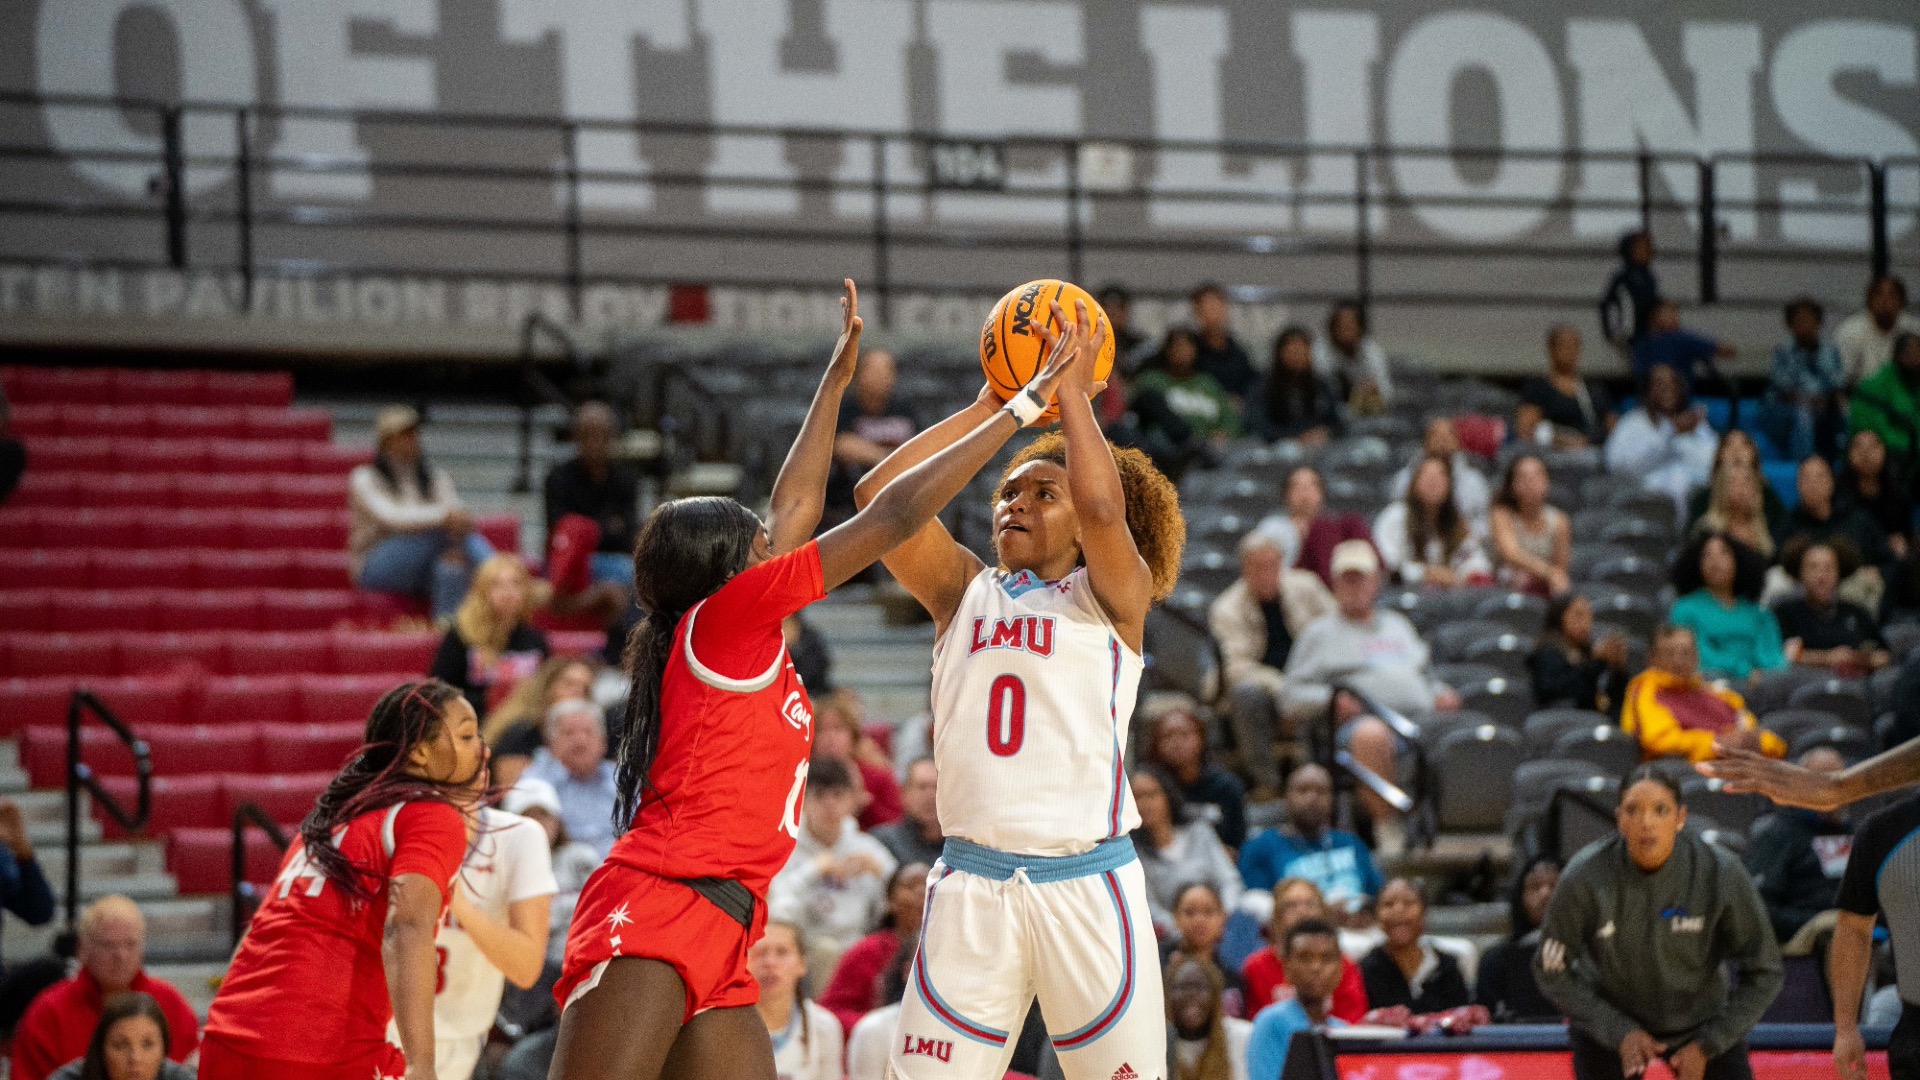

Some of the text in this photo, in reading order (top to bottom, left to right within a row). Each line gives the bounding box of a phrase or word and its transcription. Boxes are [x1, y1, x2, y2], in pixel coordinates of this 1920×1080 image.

[33, 0, 1920, 250] OF THE LIONS
[1012, 284, 1044, 336] NCAA
[968, 614, 1056, 659] LMU
[986, 673, 1026, 757] 0
[902, 1033, 954, 1064] LMU
